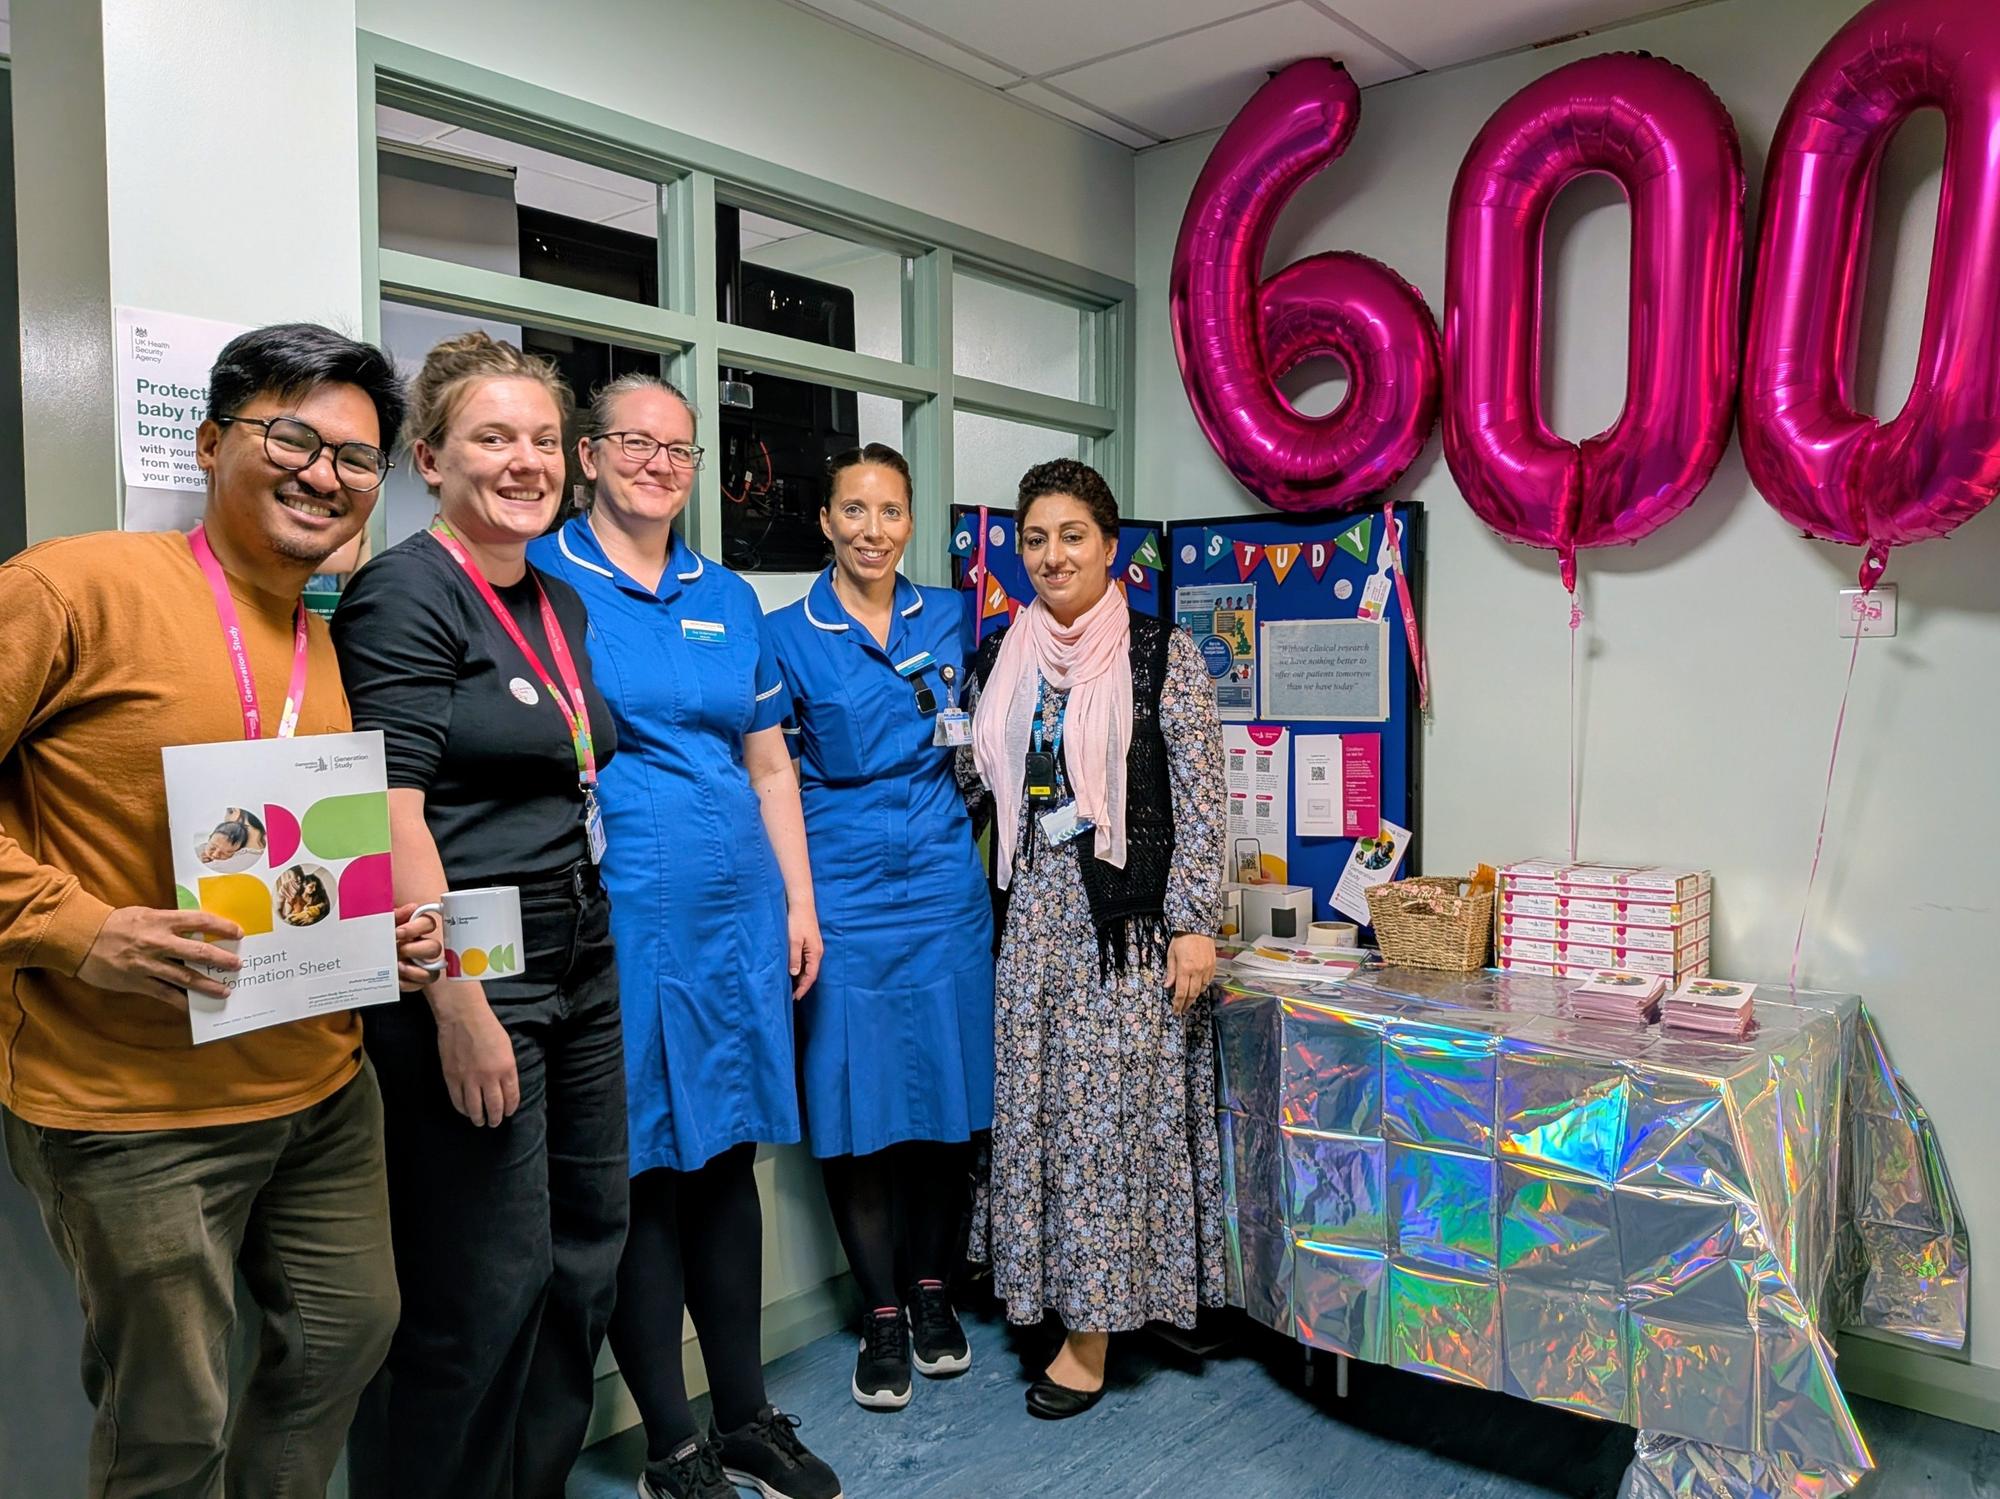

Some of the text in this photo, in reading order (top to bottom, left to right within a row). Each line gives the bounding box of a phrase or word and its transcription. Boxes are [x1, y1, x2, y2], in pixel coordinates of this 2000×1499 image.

[135, 338, 170, 349] UK Health
[135, 346, 163, 356] Security
[135, 354, 162, 364] Agency
[136, 378, 208, 400] Protect
[137, 400, 206, 422] baby fr
[138, 421, 199, 441] bronc
[140, 444, 166, 455] with
[140, 458, 169, 469] from
[142, 472, 169, 482] your
[228, 625, 242, 651] Study
[1309, 644, 1336, 652] clinical
[1337, 643, 1369, 652] research
[1307, 657, 1335, 667] nothing
[1336, 656, 1358, 665] better
[237, 652, 253, 703] Generation
[1305, 670, 1334, 680] patients
[1335, 670, 1371, 678] tomorrow
[1315, 682, 1333, 690] have
[334, 754, 369, 762] Generation
[334, 761, 353, 769] Study
[207, 950, 288, 975] Pacipant
[222, 957, 342, 990] formation Sheet
